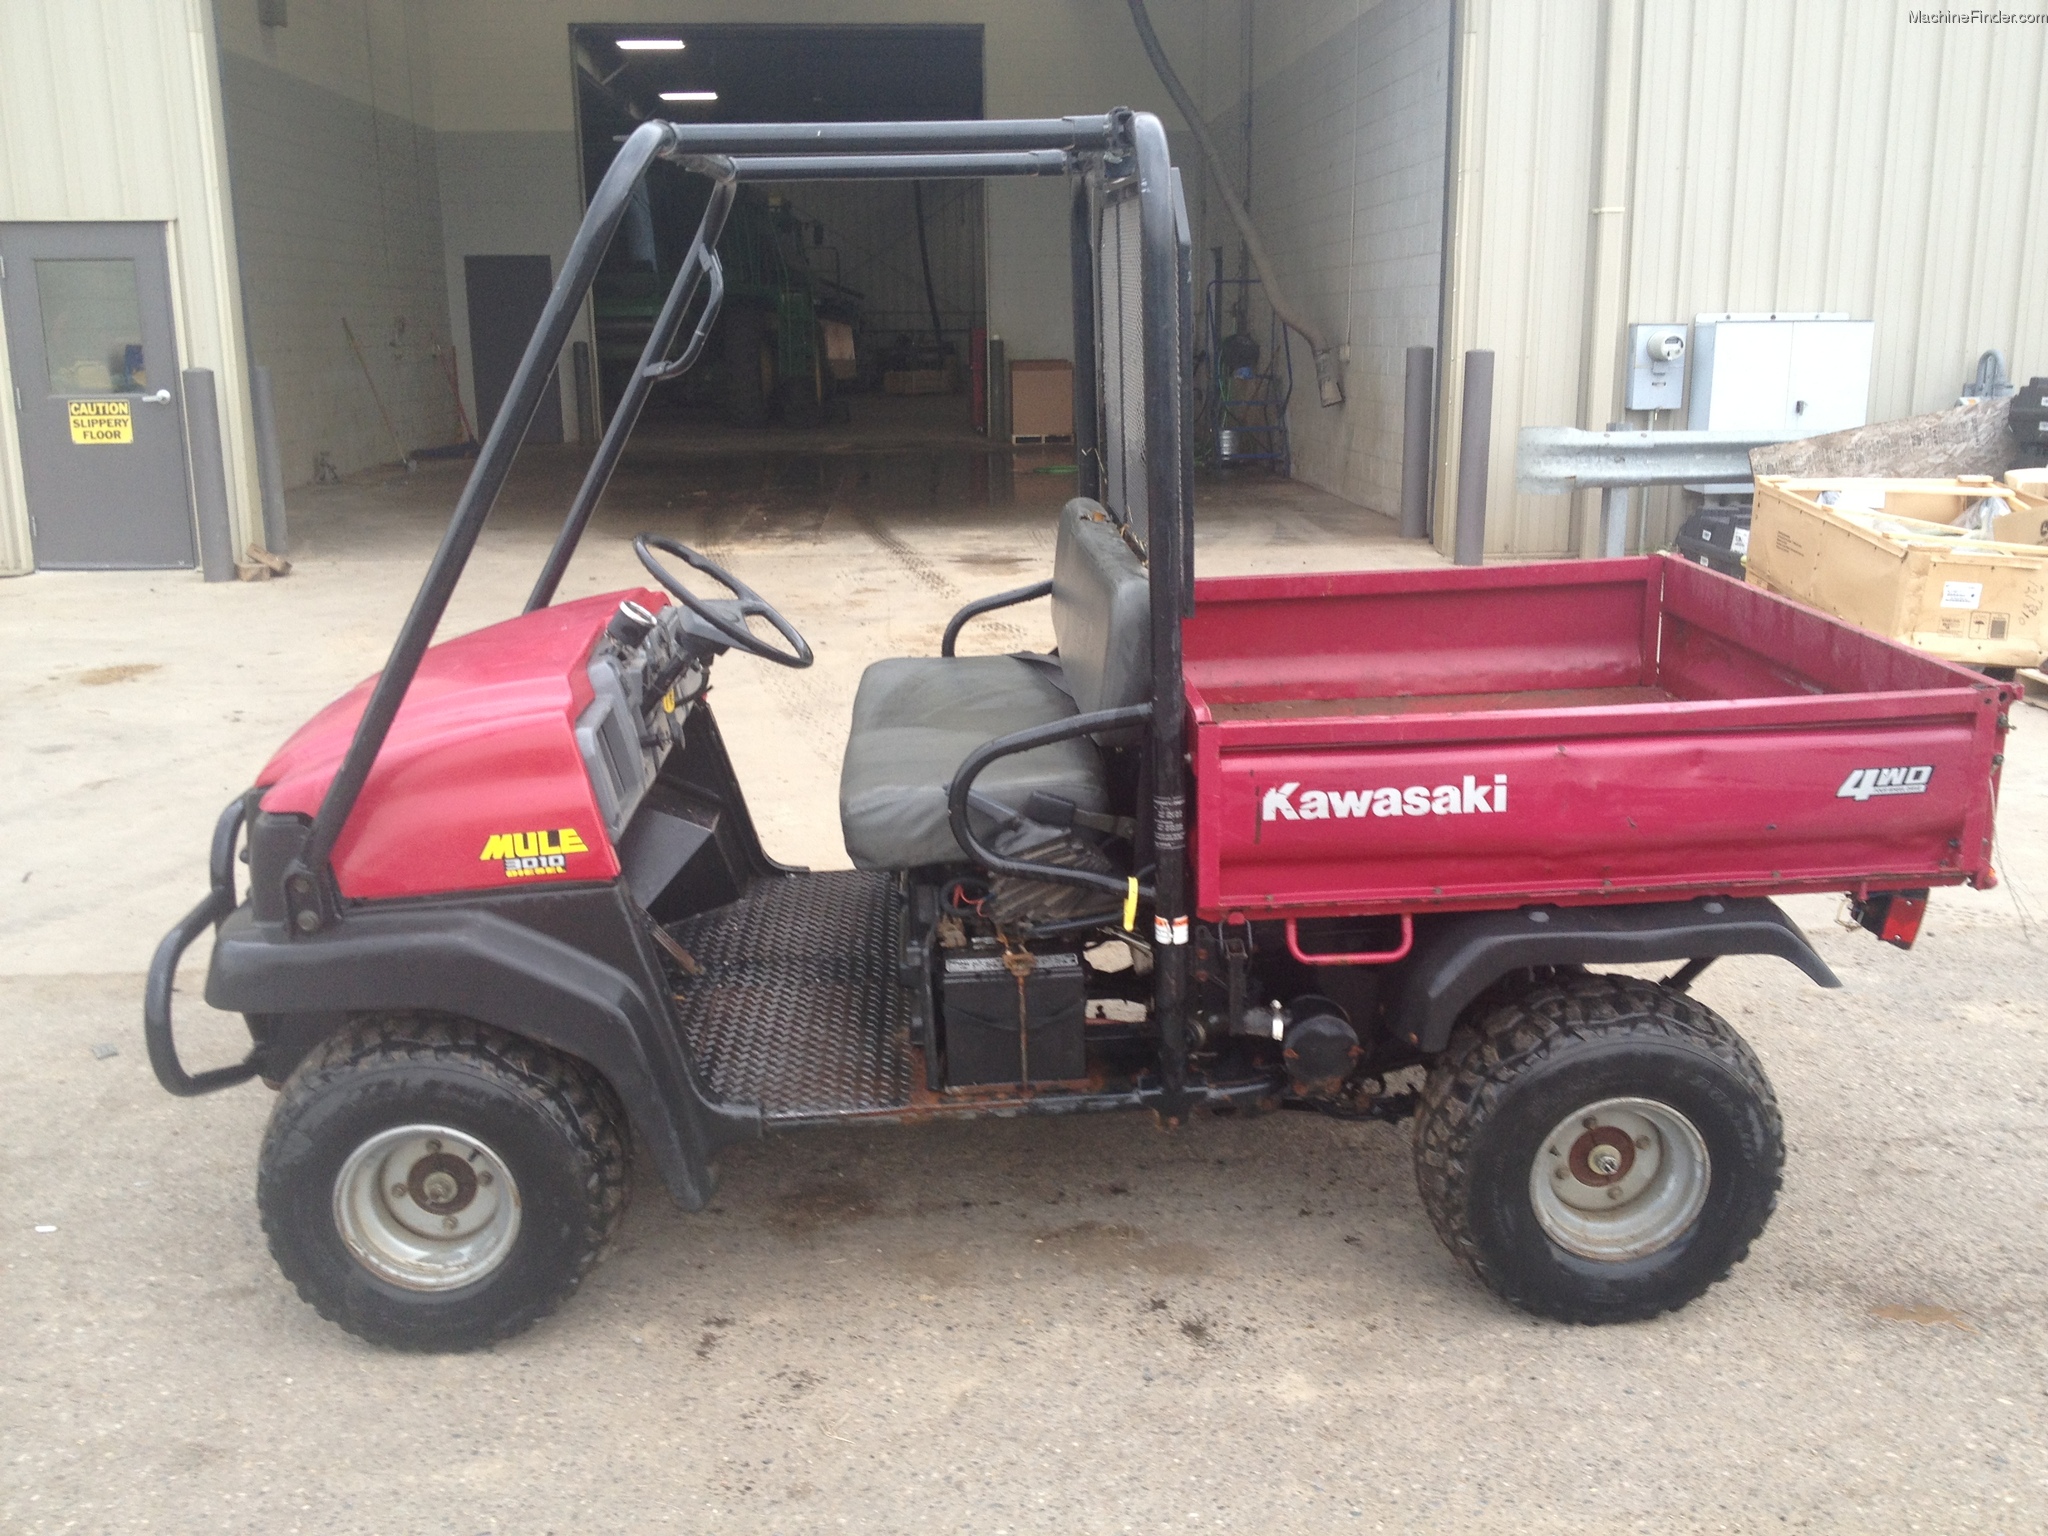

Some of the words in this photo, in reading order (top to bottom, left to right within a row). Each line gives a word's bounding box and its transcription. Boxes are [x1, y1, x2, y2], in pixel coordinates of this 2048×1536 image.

[70, 402, 129, 415] CAUTION
[73, 418, 129, 428] SLIPPERY
[83, 430, 121, 440] FLOOR
[1836, 765, 1934, 801] 4WD
[1262, 773, 1508, 821] Kawasaki
[480, 828, 589, 861] MULE
[504, 854, 566, 871] 3010
